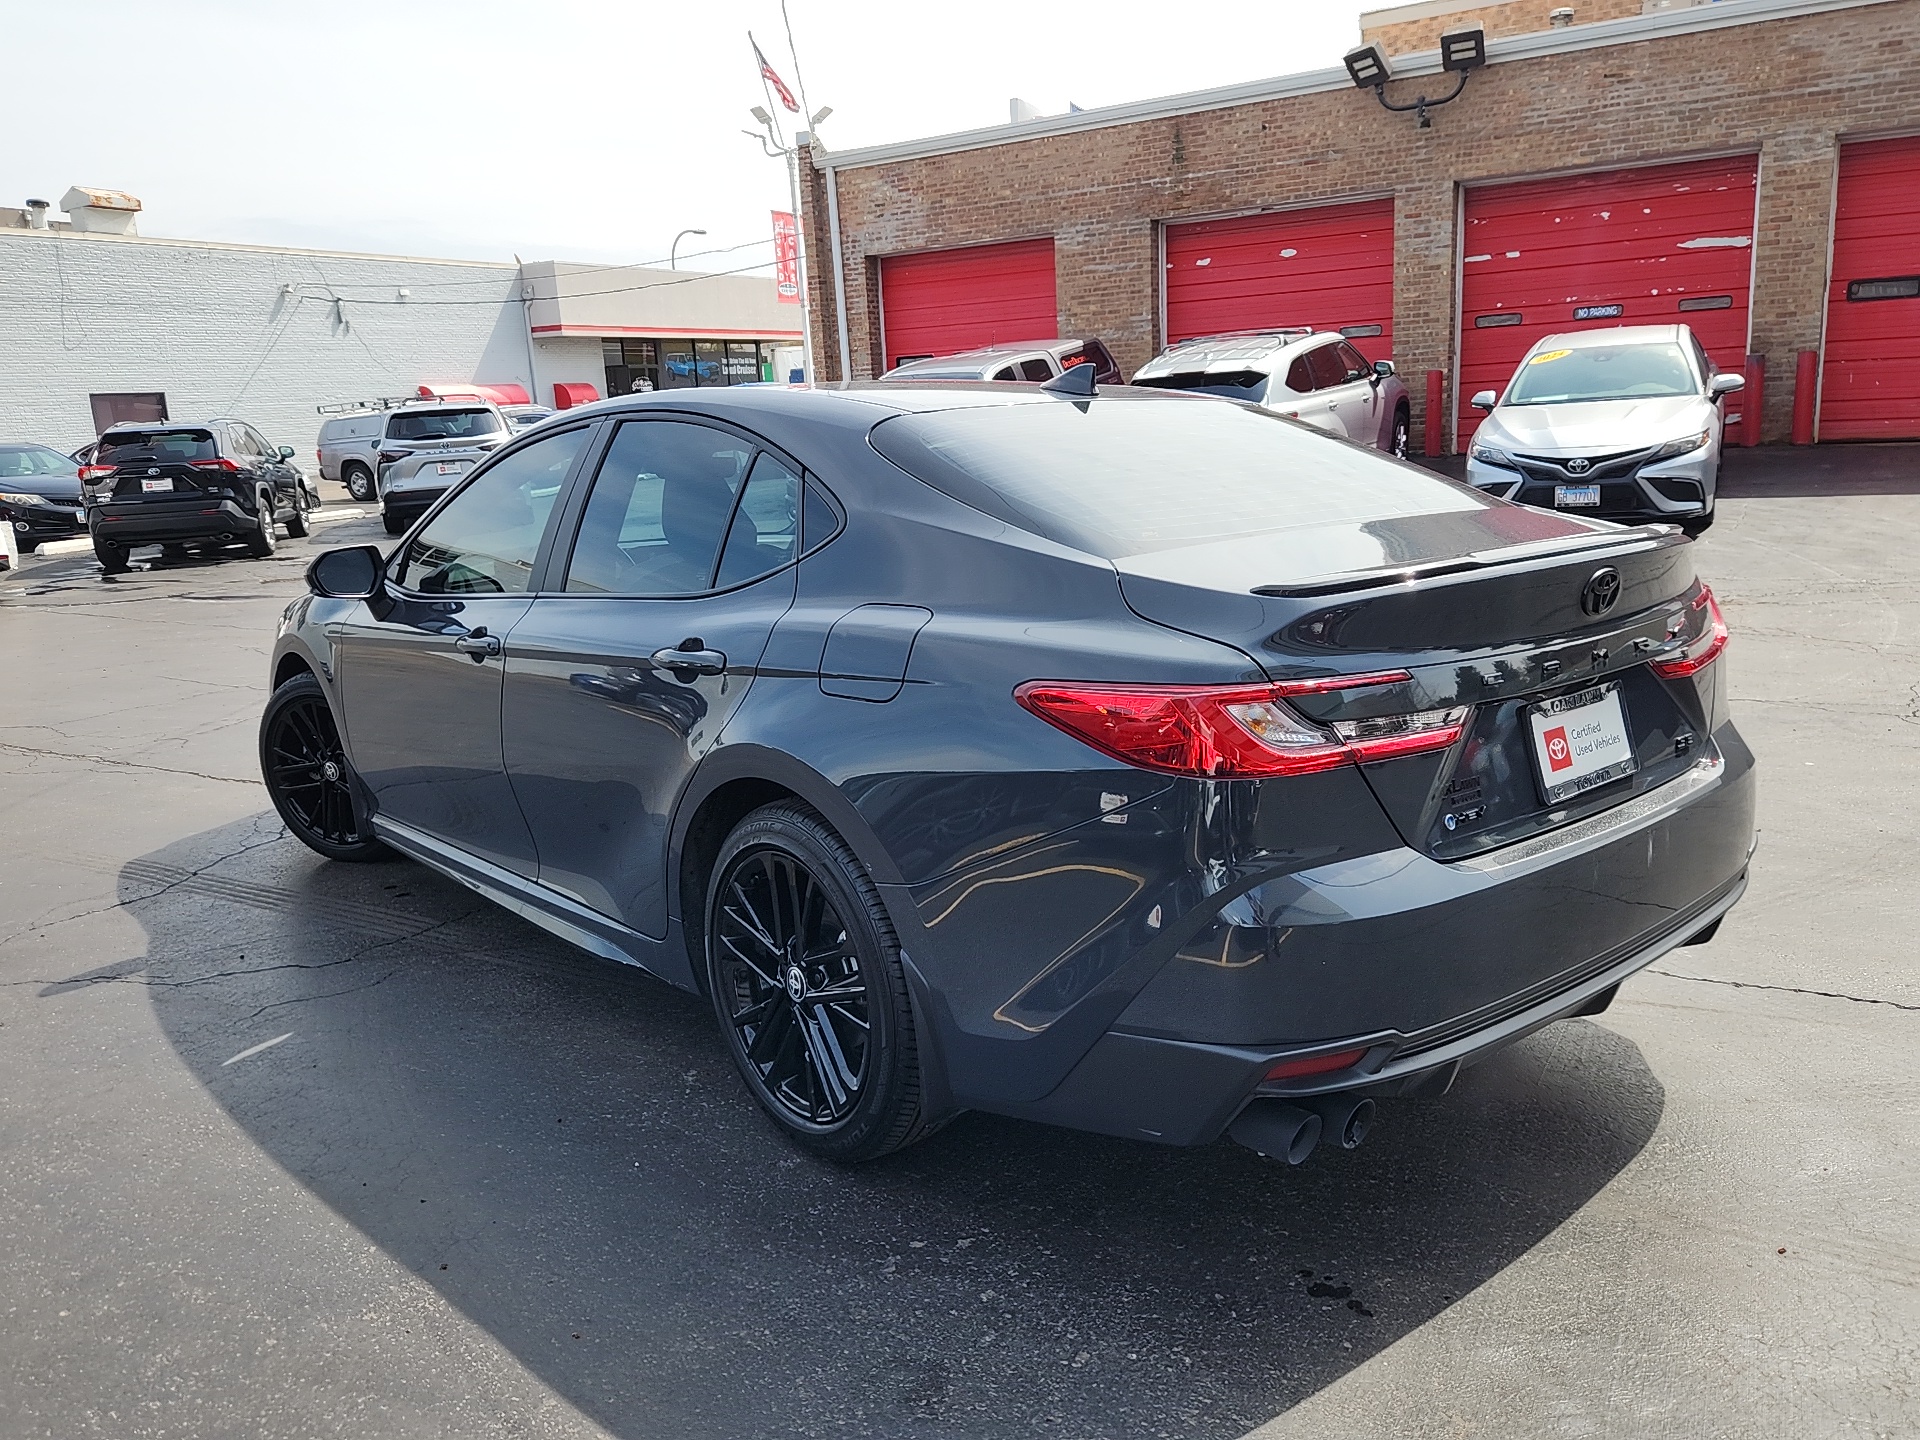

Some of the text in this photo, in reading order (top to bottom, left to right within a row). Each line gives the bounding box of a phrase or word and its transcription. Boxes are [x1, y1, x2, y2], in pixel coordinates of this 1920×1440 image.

[788, 236, 796, 282] CARS
[1578, 306, 1618, 317] NO PARKING
[1553, 696, 1575, 711] OAK
[1571, 720, 1602, 739] Certified
[1575, 733, 1621, 756] Used Vehicles
[1573, 769, 1612, 791] TOYOTA
